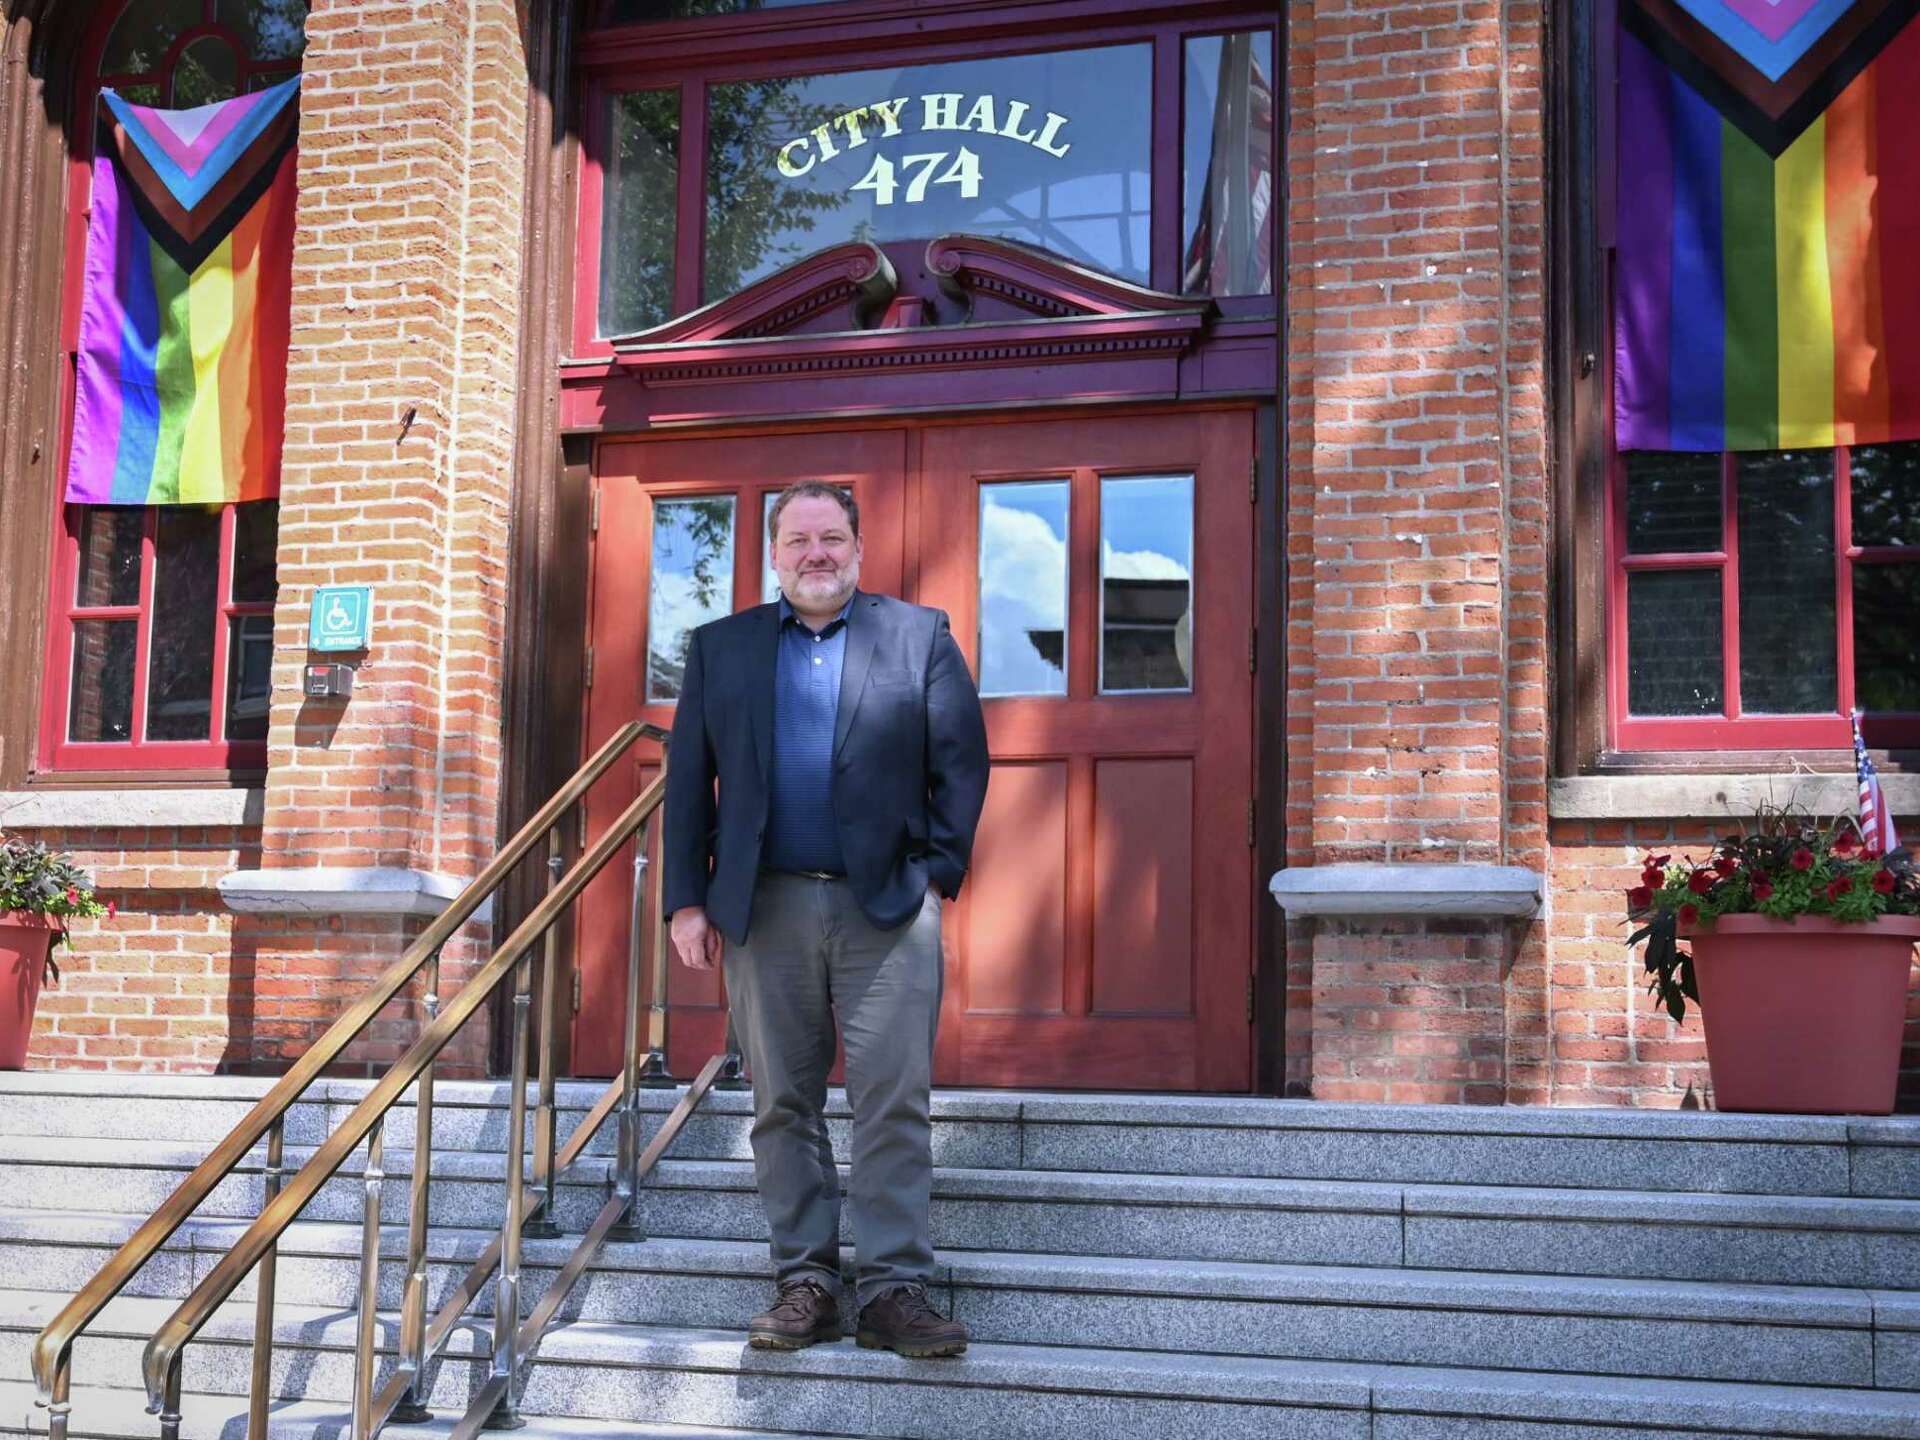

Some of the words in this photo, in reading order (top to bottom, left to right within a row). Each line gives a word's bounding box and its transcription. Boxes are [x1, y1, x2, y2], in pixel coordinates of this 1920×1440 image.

[777, 98, 908, 178] CITY
[920, 93, 1070, 158] HALL
[849, 146, 983, 205] 474
